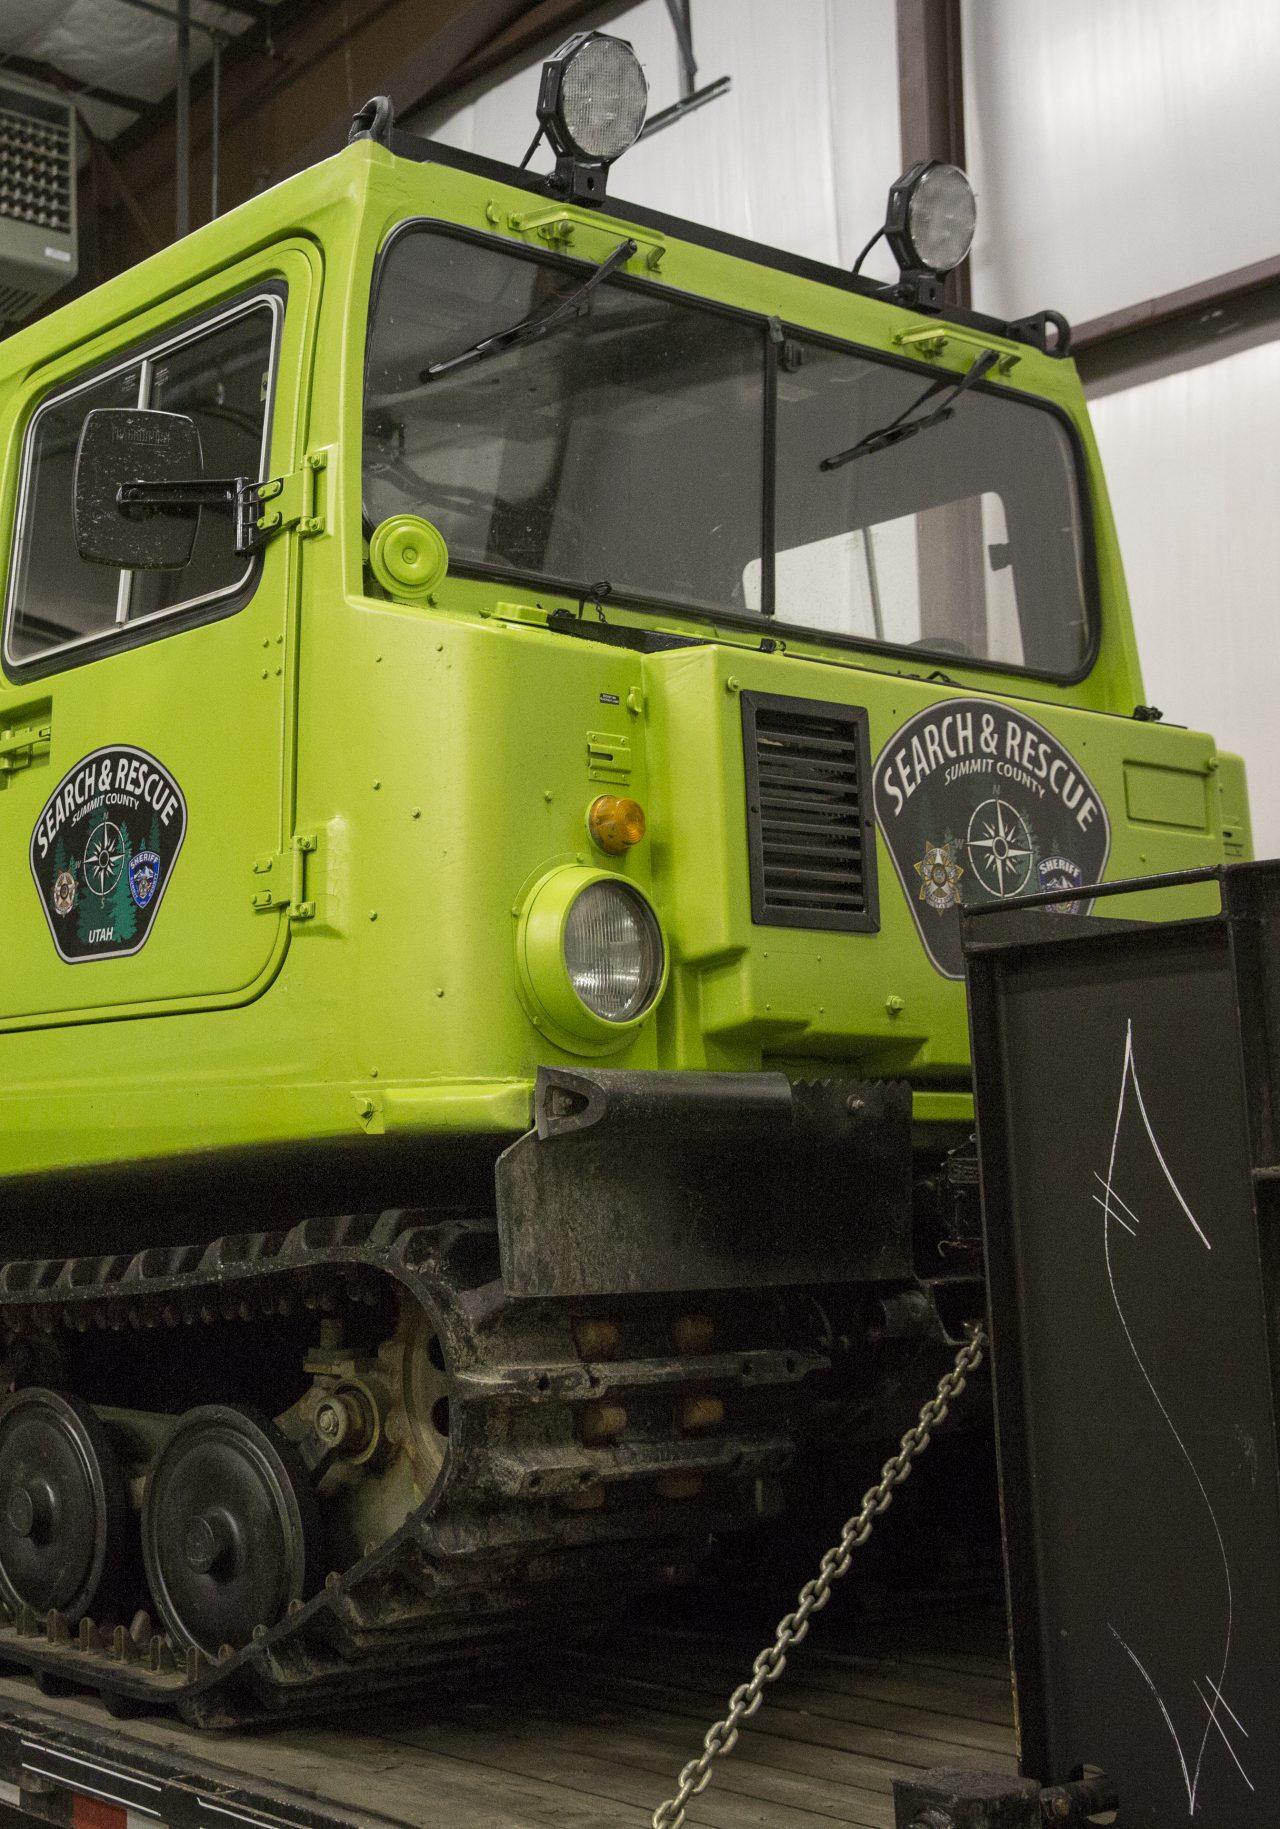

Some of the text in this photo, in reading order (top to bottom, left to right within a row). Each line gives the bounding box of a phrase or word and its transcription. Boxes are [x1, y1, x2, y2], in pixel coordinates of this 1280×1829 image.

[884, 712, 1099, 832] SEARCH & RESCUE
[944, 758, 1046, 799] SUMMIT COUNTY
[37, 758, 179, 859] SEARCH & RESCUE
[71, 793, 140, 827] SUMMIT COUNTY
[130, 853, 159, 869] SHERIFF
[1039, 858, 1080, 878] SHERIFF
[88, 927, 113, 943] UTAH
